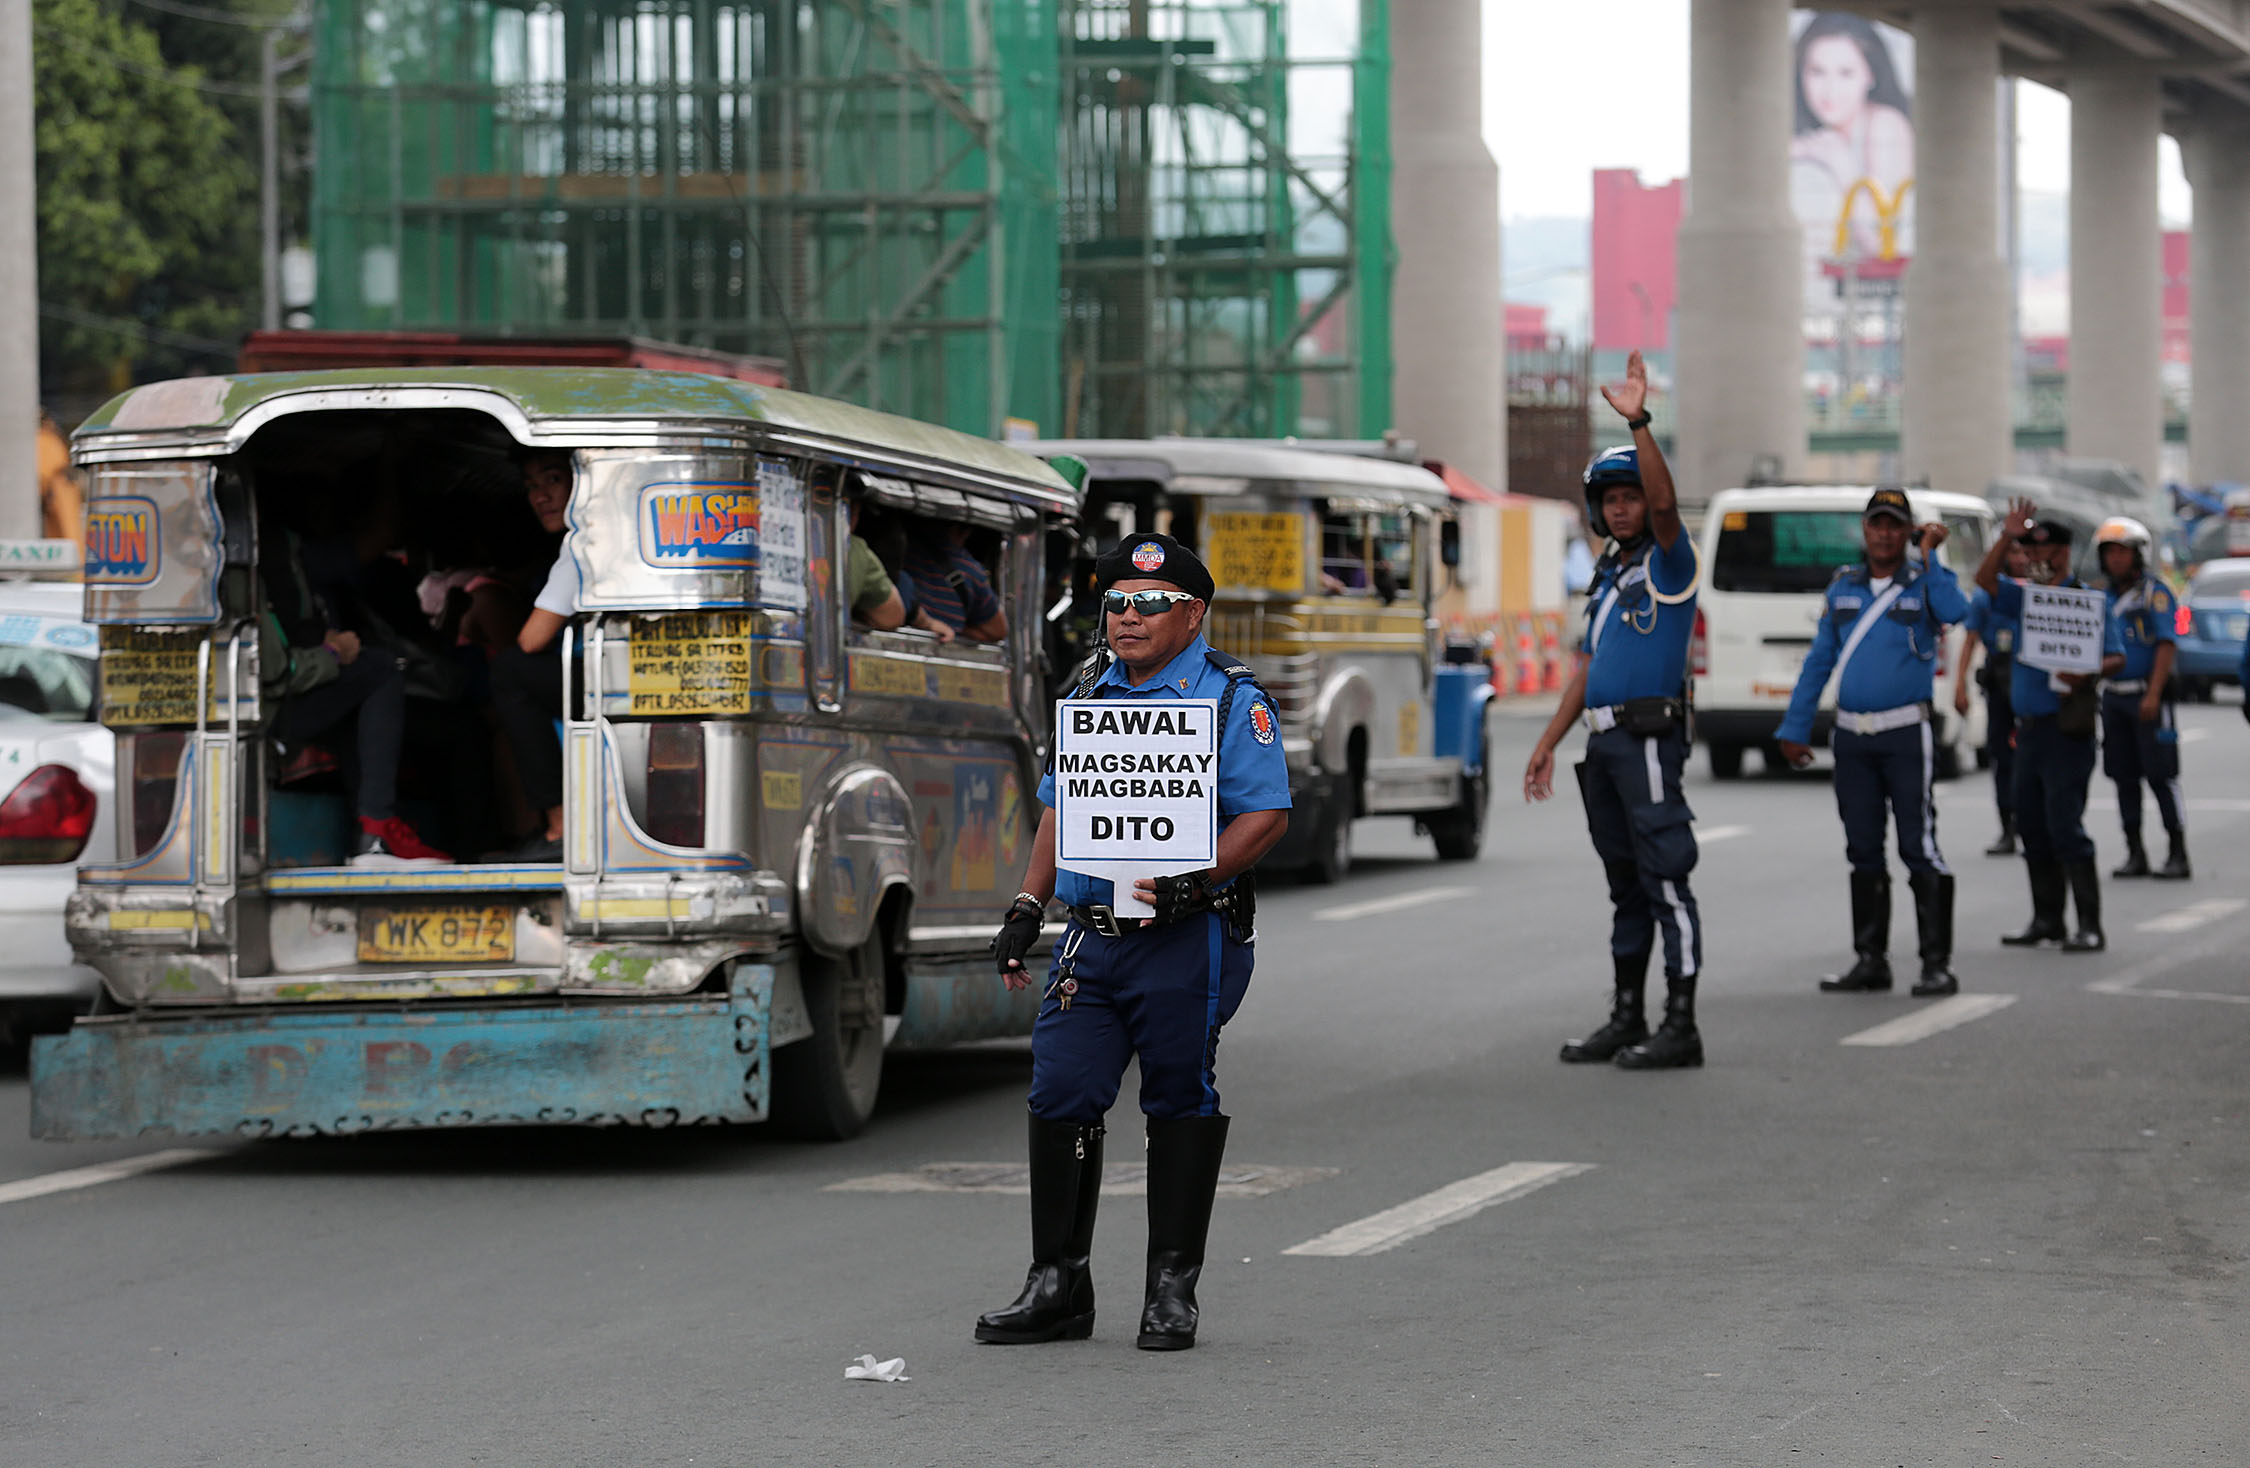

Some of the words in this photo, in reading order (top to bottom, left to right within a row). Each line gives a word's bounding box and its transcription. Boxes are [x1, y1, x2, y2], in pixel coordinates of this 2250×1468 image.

[1073, 711, 1196, 735] BAWAL
[1059, 754, 1213, 773] MAGSAKAY
[1068, 779, 1204, 797] MAGBABA
[1091, 816, 1174, 841] DITO
